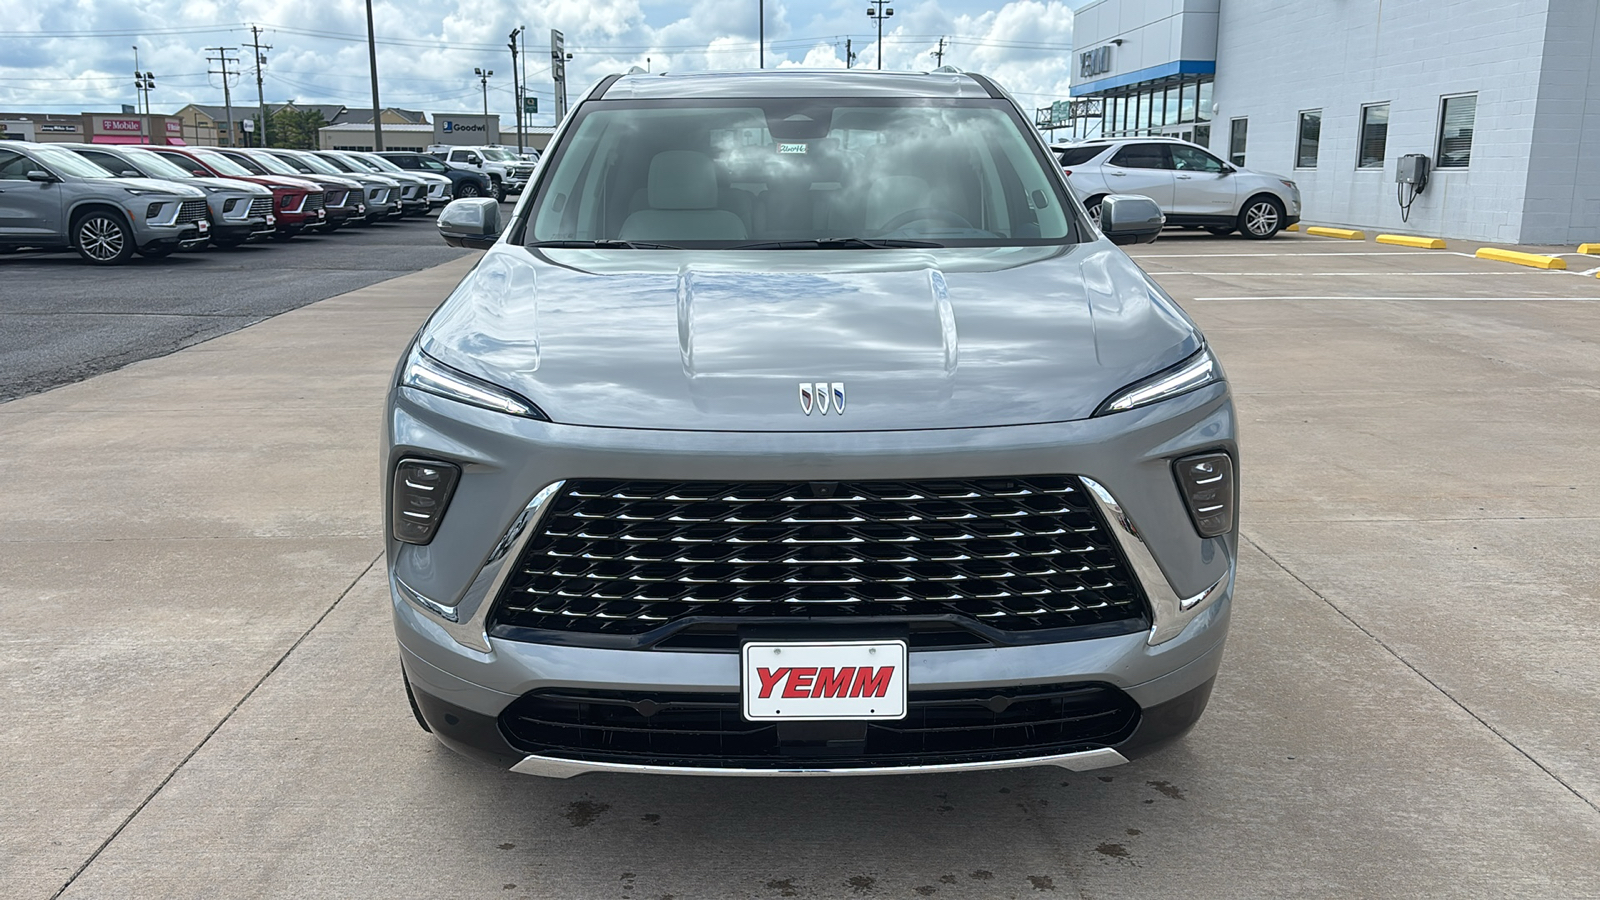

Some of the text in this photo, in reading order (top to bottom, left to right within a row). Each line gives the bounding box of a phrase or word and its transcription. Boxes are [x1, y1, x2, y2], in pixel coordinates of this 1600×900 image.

[112, 121, 139, 130] Mobile
[453, 123, 489, 132] Goodwi
[756, 666, 895, 699] YEMM
